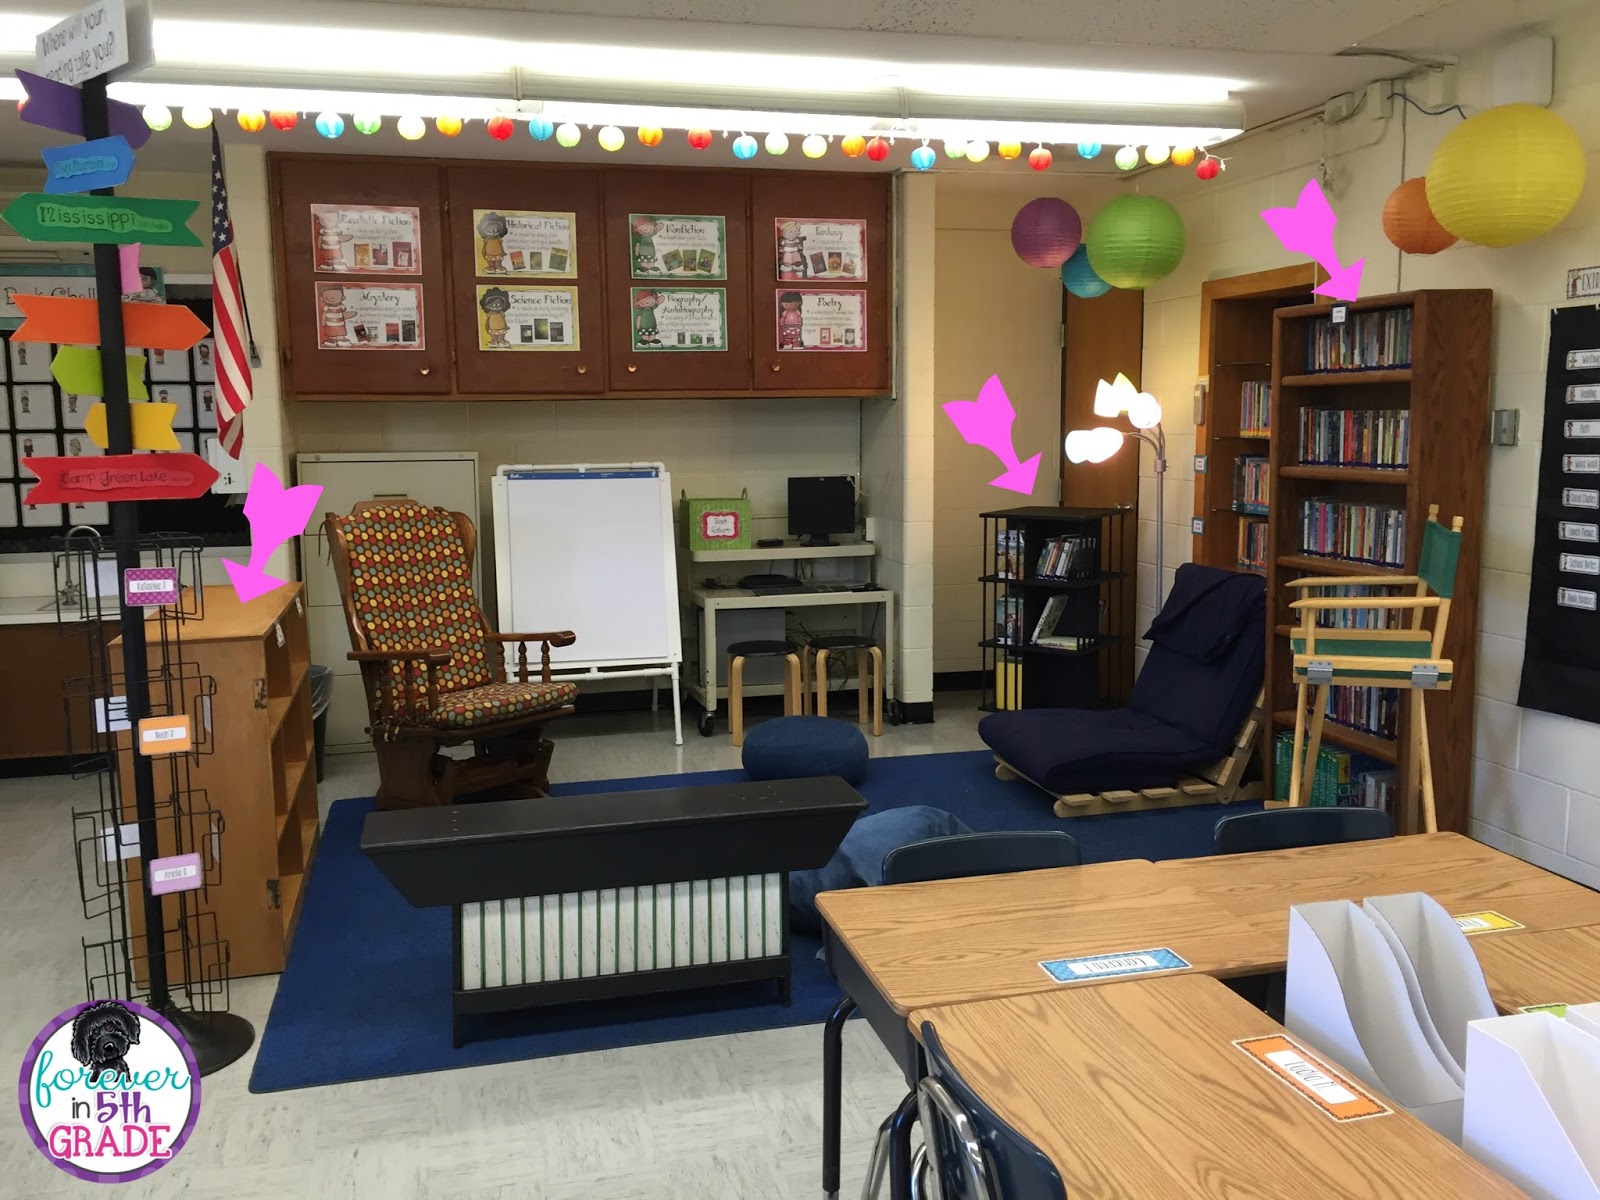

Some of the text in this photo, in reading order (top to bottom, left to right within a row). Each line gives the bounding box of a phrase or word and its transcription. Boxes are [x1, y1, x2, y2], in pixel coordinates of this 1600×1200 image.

[42, 29, 66, 57] Where
[84, 8, 104, 39] your
[93, 31, 115, 70] you?
[39, 206, 136, 230] Mississippi
[382, 214, 412, 226] Fiction
[507, 219, 570, 231] Historical Fiction
[666, 223, 705, 235] Nonfiction
[815, 226, 844, 240] Fantasy
[360, 291, 401, 306] Mystery
[510, 294, 572, 305] Science Fiction
[817, 297, 843, 311] Poetry
[662, 305, 714, 317] Autobiography
[62, 472, 96, 486] Camp
[139, 471, 168, 483] Lake
[710, 517, 731, 534] Book Return
